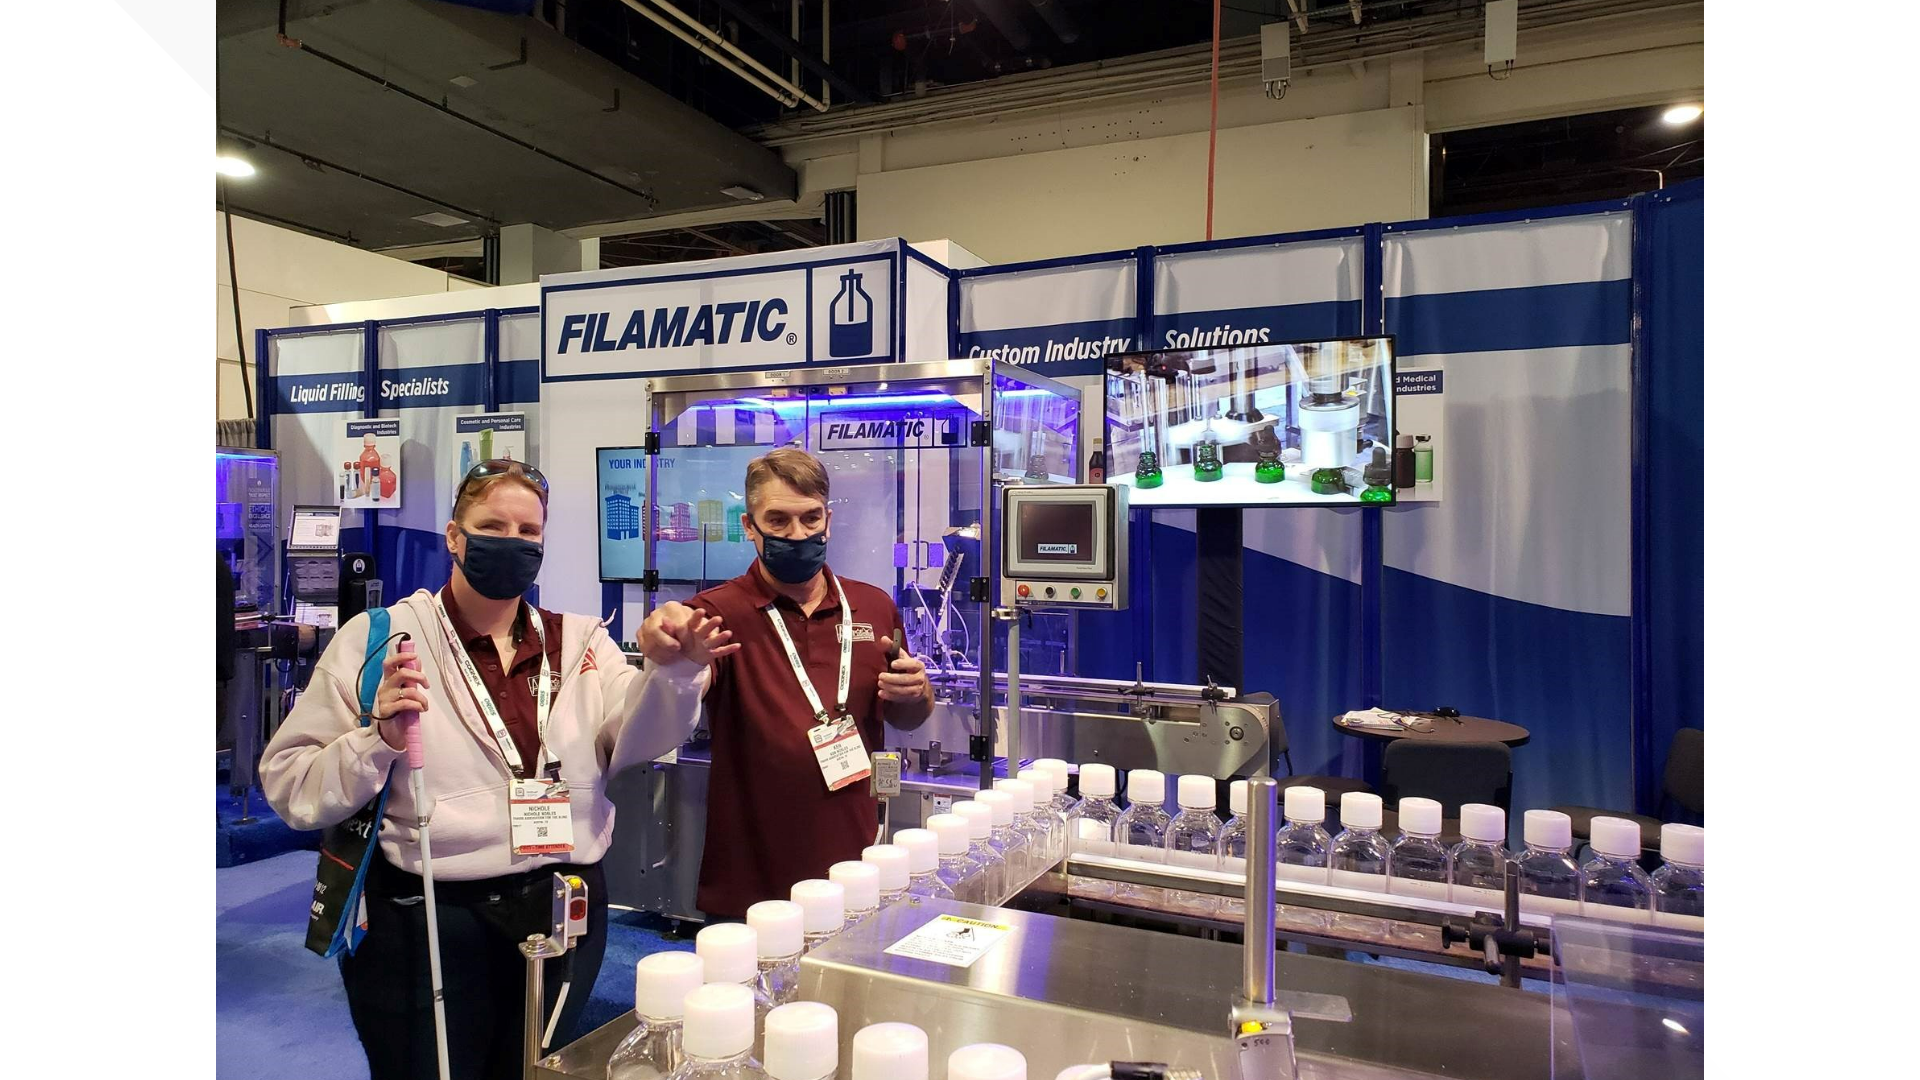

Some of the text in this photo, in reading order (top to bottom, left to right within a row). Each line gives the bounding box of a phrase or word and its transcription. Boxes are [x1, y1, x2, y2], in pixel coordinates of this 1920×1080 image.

[557, 297, 788, 354] FILAMATIC
[1402, 374, 1436, 383] Medical
[291, 377, 449, 405] Liquid Filling Specialists
[1396, 384, 1436, 392] ndustries
[827, 421, 925, 440] FILAMATIC
[609, 458, 632, 469] YOUR
[464, 659, 481, 686] COGNEX
[957, 918, 999, 929] CAUTION
[1254, 1039, 1270, 1047] 500
